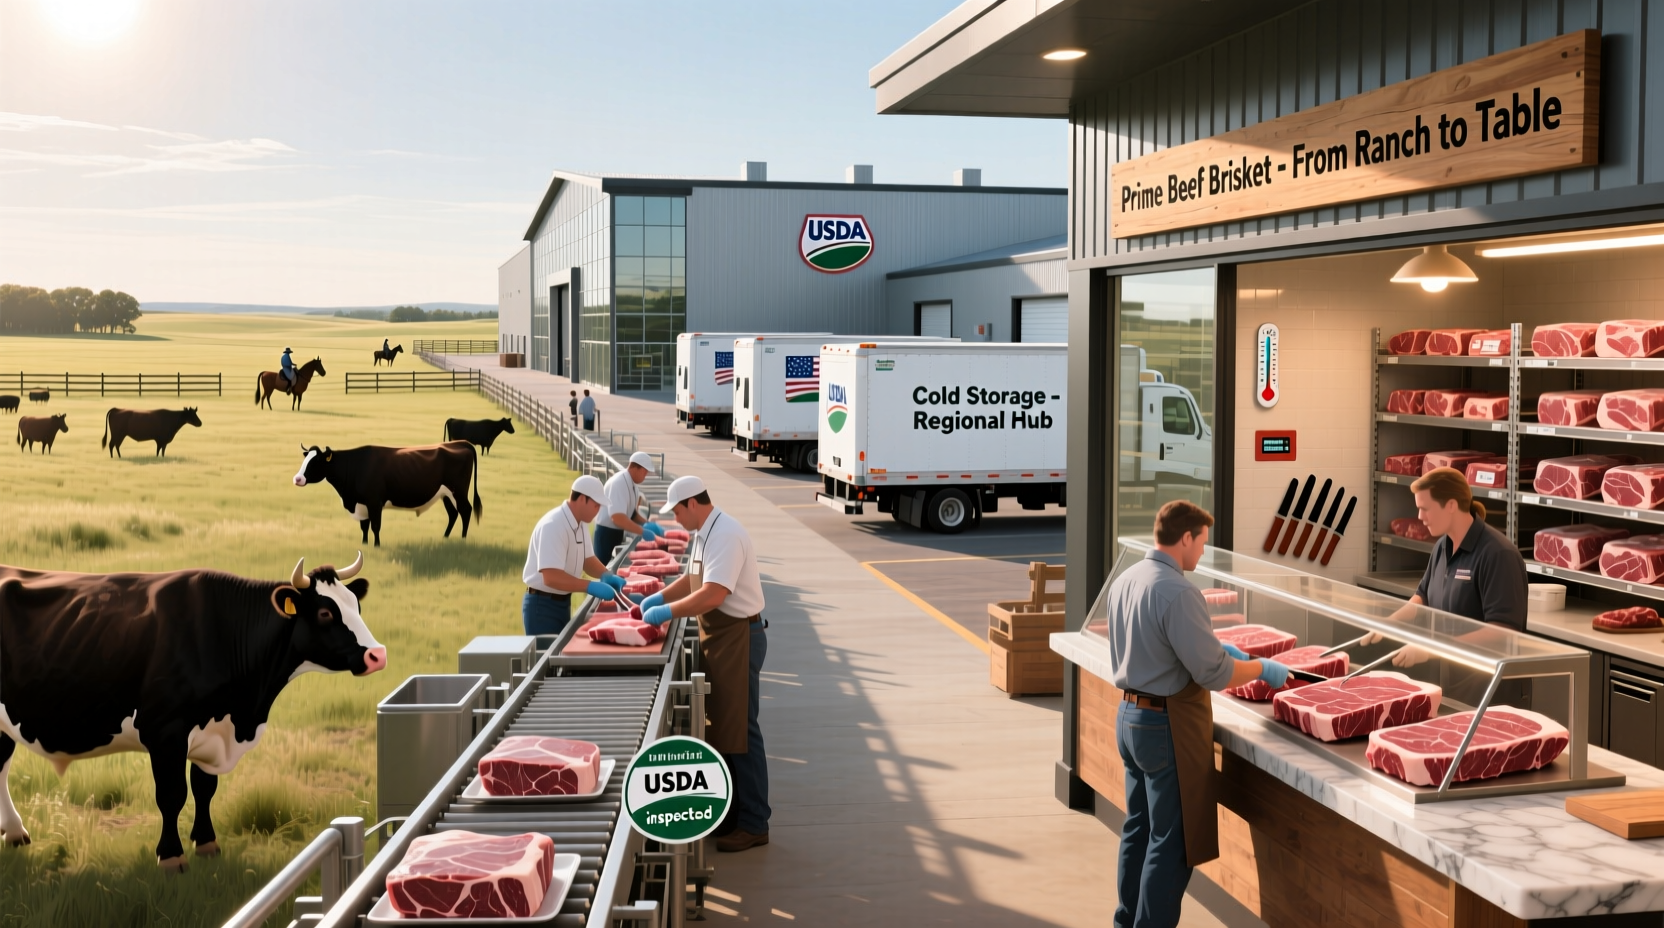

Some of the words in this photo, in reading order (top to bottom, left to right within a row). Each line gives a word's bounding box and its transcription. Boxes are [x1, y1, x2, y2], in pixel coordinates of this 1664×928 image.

[1121, 180, 1163, 213] Prime
[1168, 167, 1205, 203] Beef
[1209, 156, 1272, 195] Brisket
[1293, 143, 1348, 179] From
[1355, 115, 1431, 167] Ranch
[1438, 114, 1468, 149] to
[1475, 87, 1562, 143] Table
[808, 219, 867, 241] USDA
[912, 385, 960, 406] Cold
[966, 385, 1047, 410] Storage
[913, 410, 1005, 435] Regional
[1011, 410, 1053, 430] Hub
[644, 770, 709, 794] USDA
